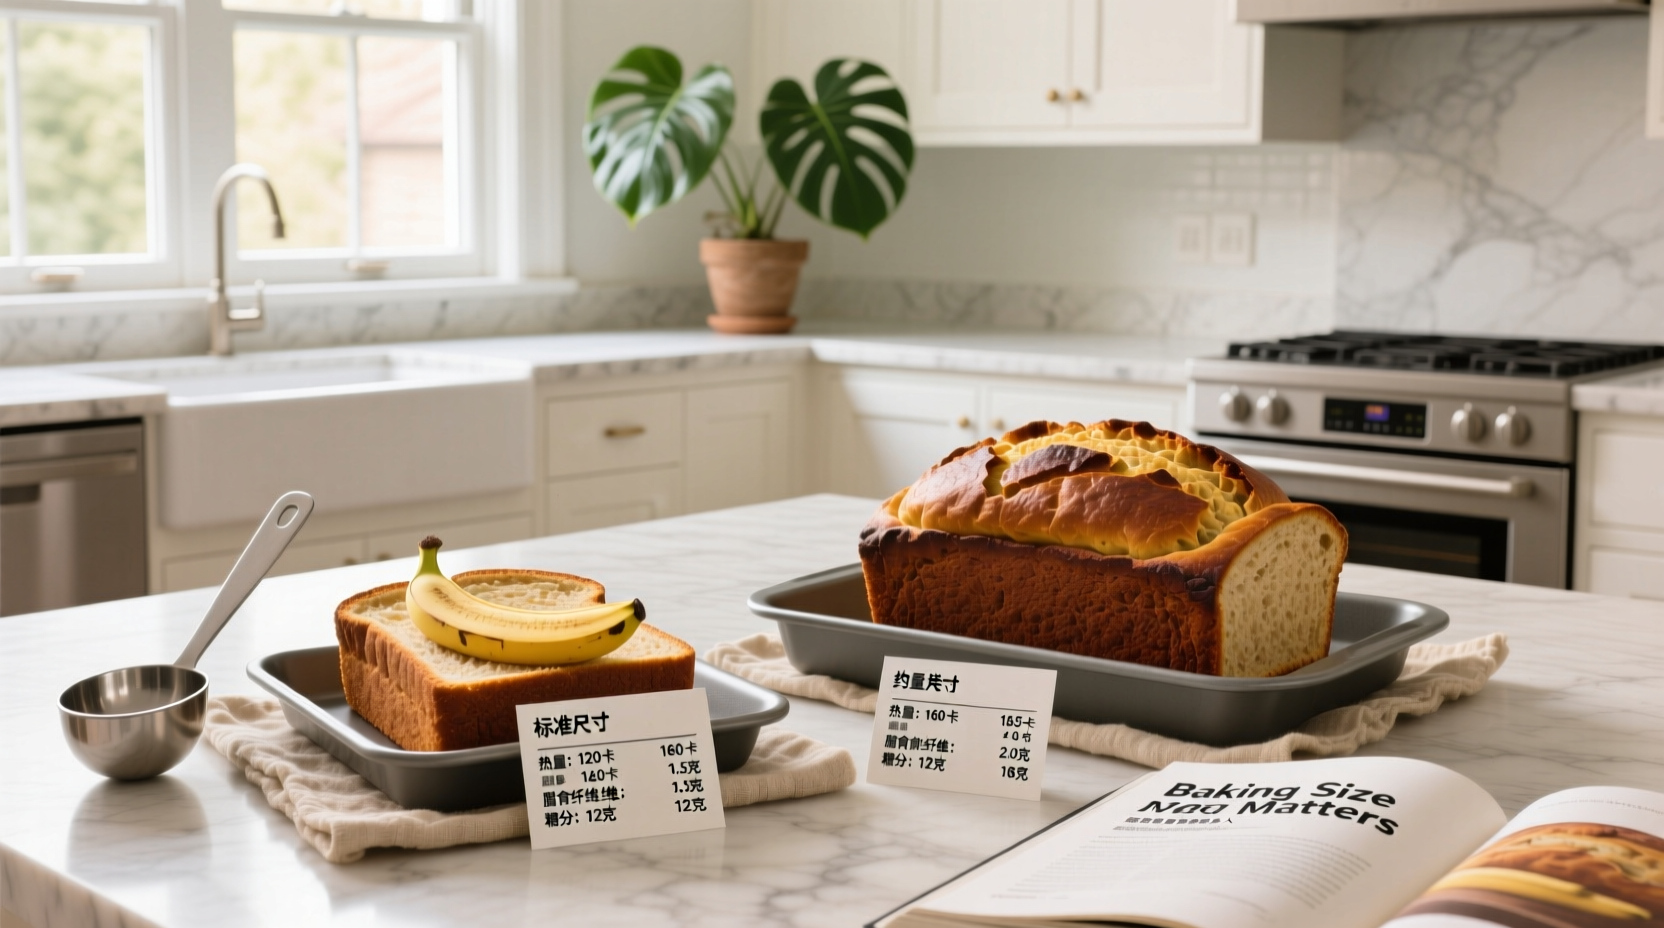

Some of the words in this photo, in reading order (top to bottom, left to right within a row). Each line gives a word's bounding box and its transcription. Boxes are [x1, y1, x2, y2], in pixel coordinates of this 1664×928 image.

[533, 711, 610, 738] 标准尺寸
[925, 709, 959, 724] 160卡
[577, 748, 615, 765] 120卡
[1163, 782, 1301, 801] Baking
[1309, 781, 1397, 808] Size
[674, 797, 708, 813] 12克
[585, 806, 617, 823] 12克
[1236, 800, 1400, 836] Matters
